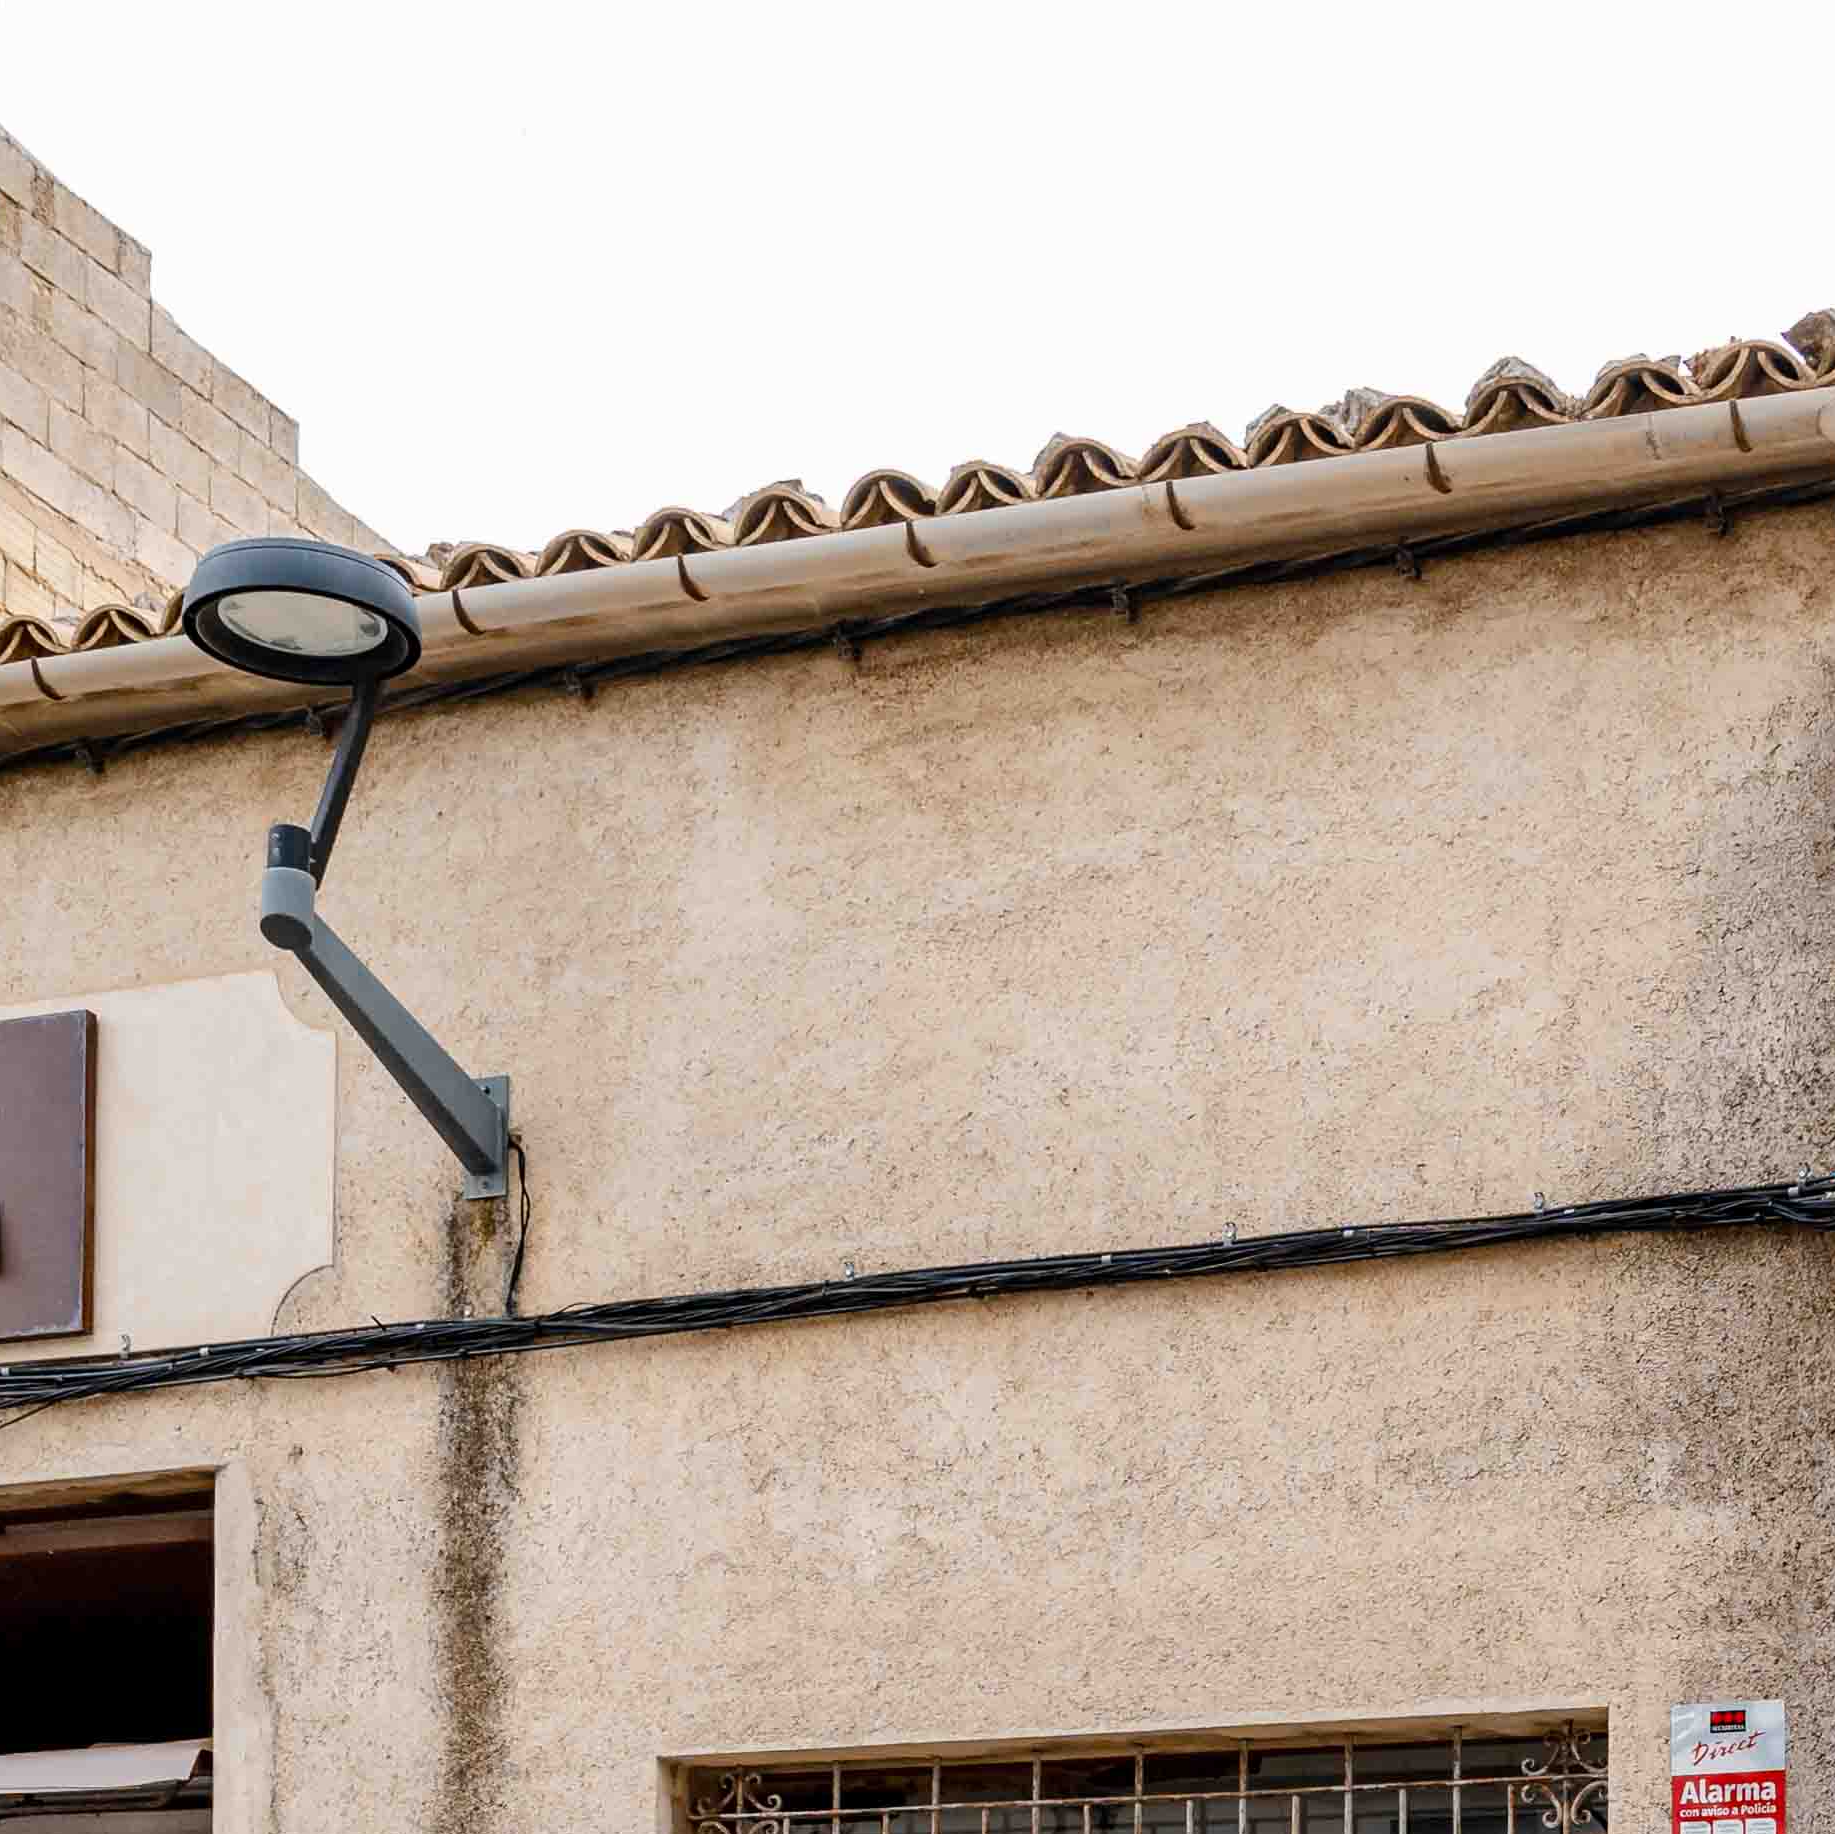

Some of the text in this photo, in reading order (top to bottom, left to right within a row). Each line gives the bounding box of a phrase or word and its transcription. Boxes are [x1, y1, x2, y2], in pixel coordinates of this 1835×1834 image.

[1692, 1730, 1767, 1766] Direct
[1679, 1778, 1777, 1805] Alarma
[1679, 1808, 1699, 1818] con
[1701, 1805, 1730, 1817] aviso
[1731, 1807, 1739, 1816] a
